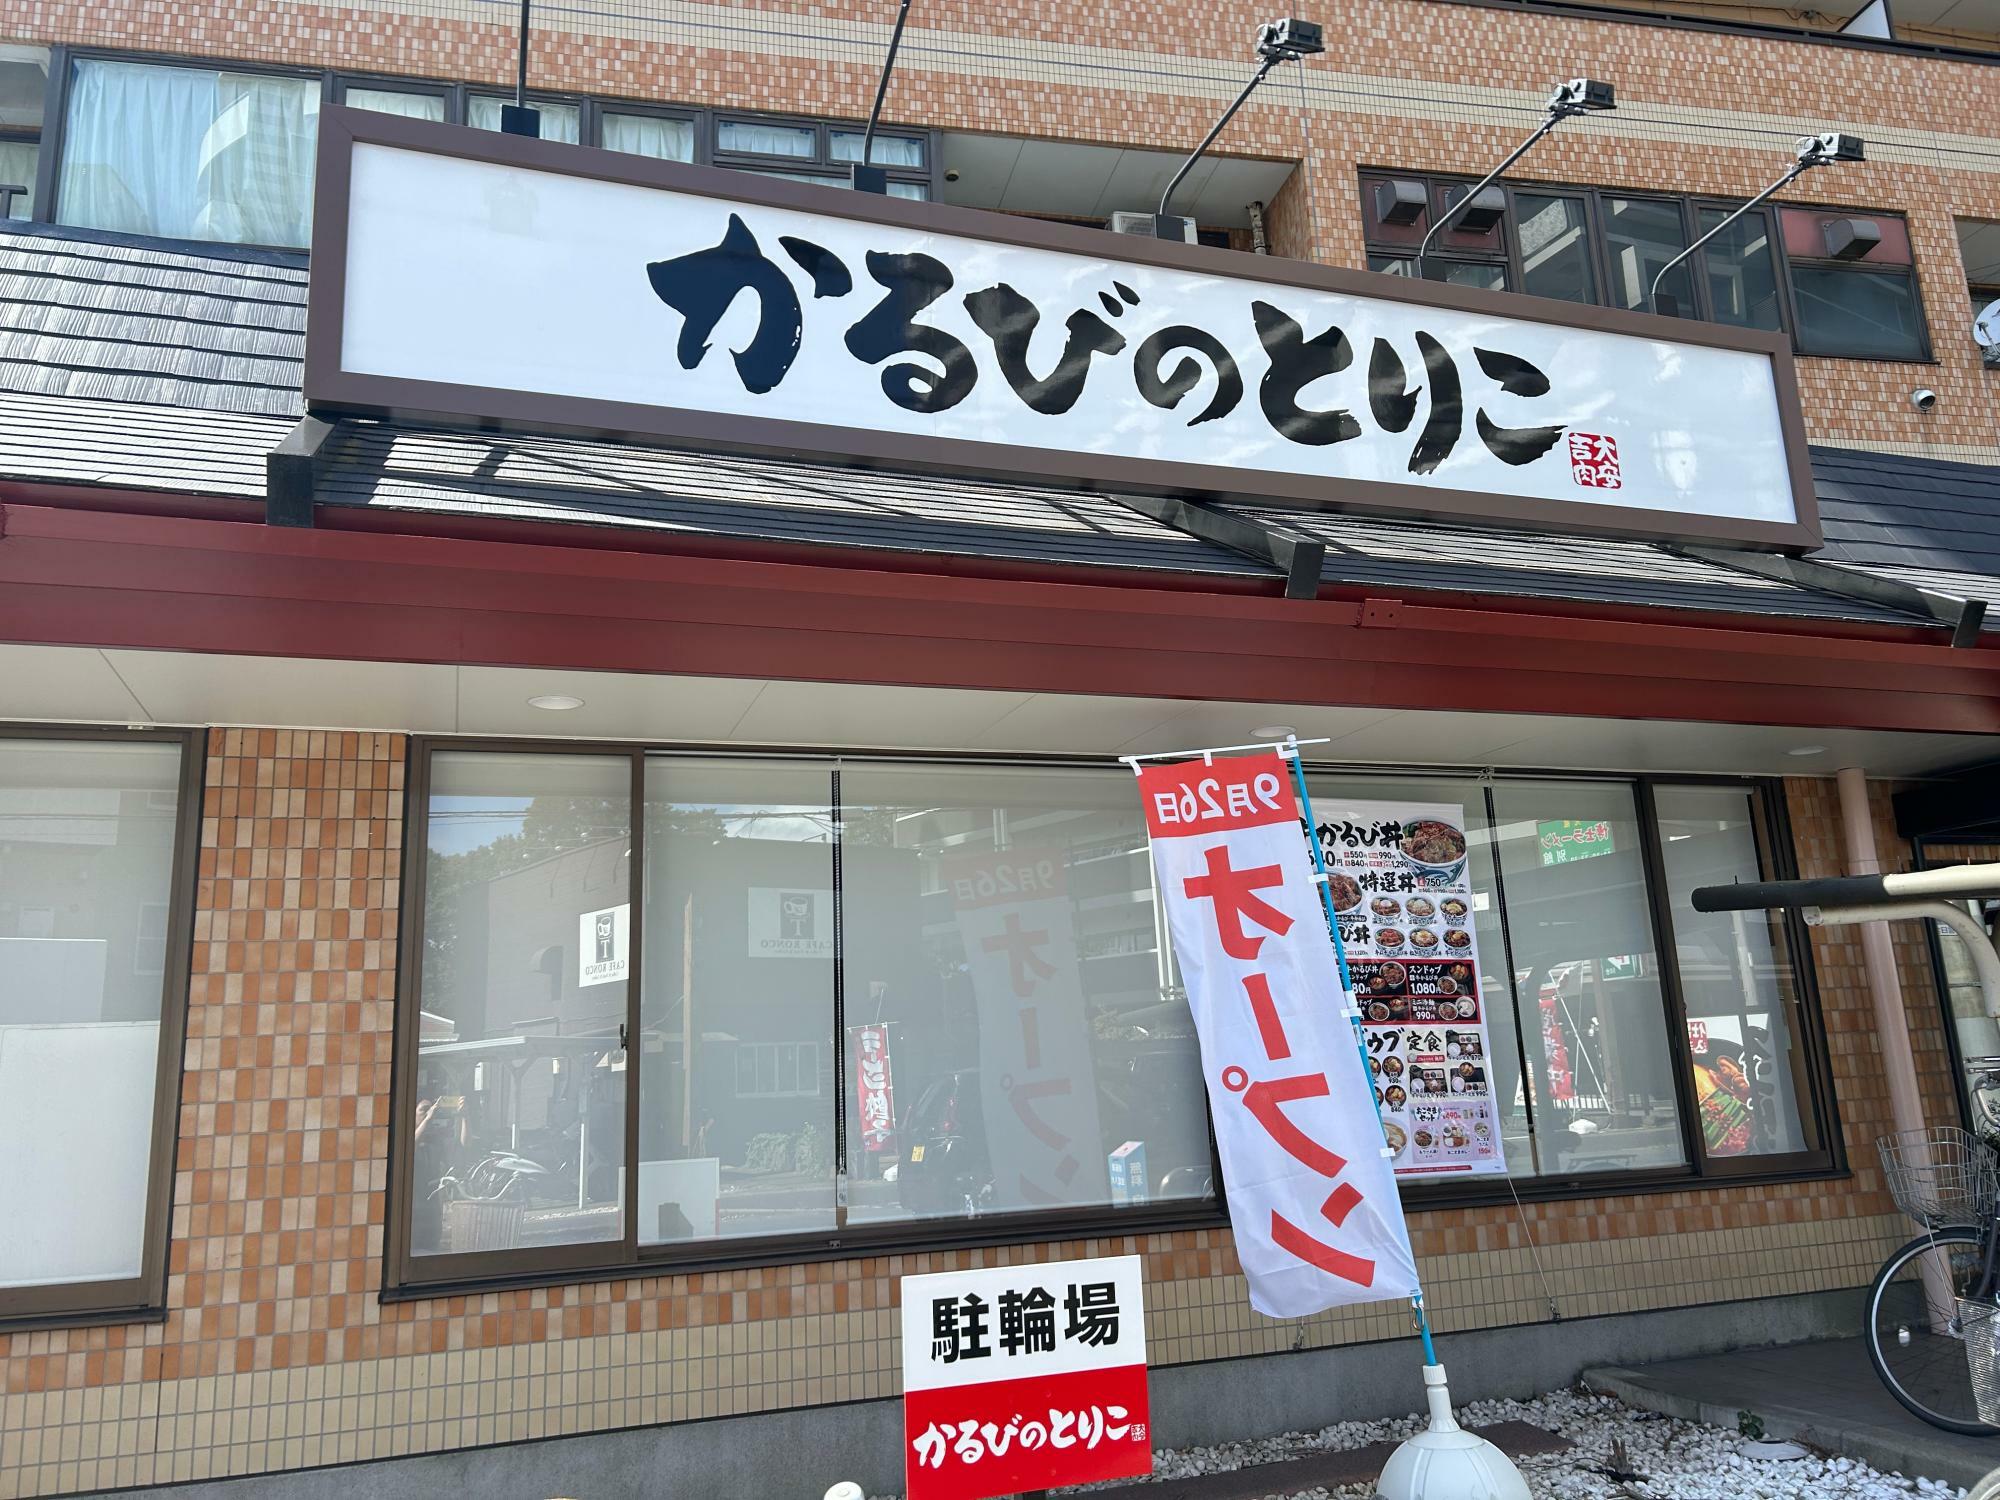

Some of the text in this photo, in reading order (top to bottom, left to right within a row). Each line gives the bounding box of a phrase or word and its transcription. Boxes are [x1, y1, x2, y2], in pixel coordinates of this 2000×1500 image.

[646, 212, 1567, 475] かるびのとりこ
[1359, 870, 1416, 893] 特選丼
[1416, 1011, 1435, 1020] 990円
[1407, 1030, 1442, 1052] 定食
[1416, 1106, 1438, 1114] おこさま
[931, 1282, 1120, 1364] 駐輪場
[912, 1405, 1131, 1469] かるびのとりこ
